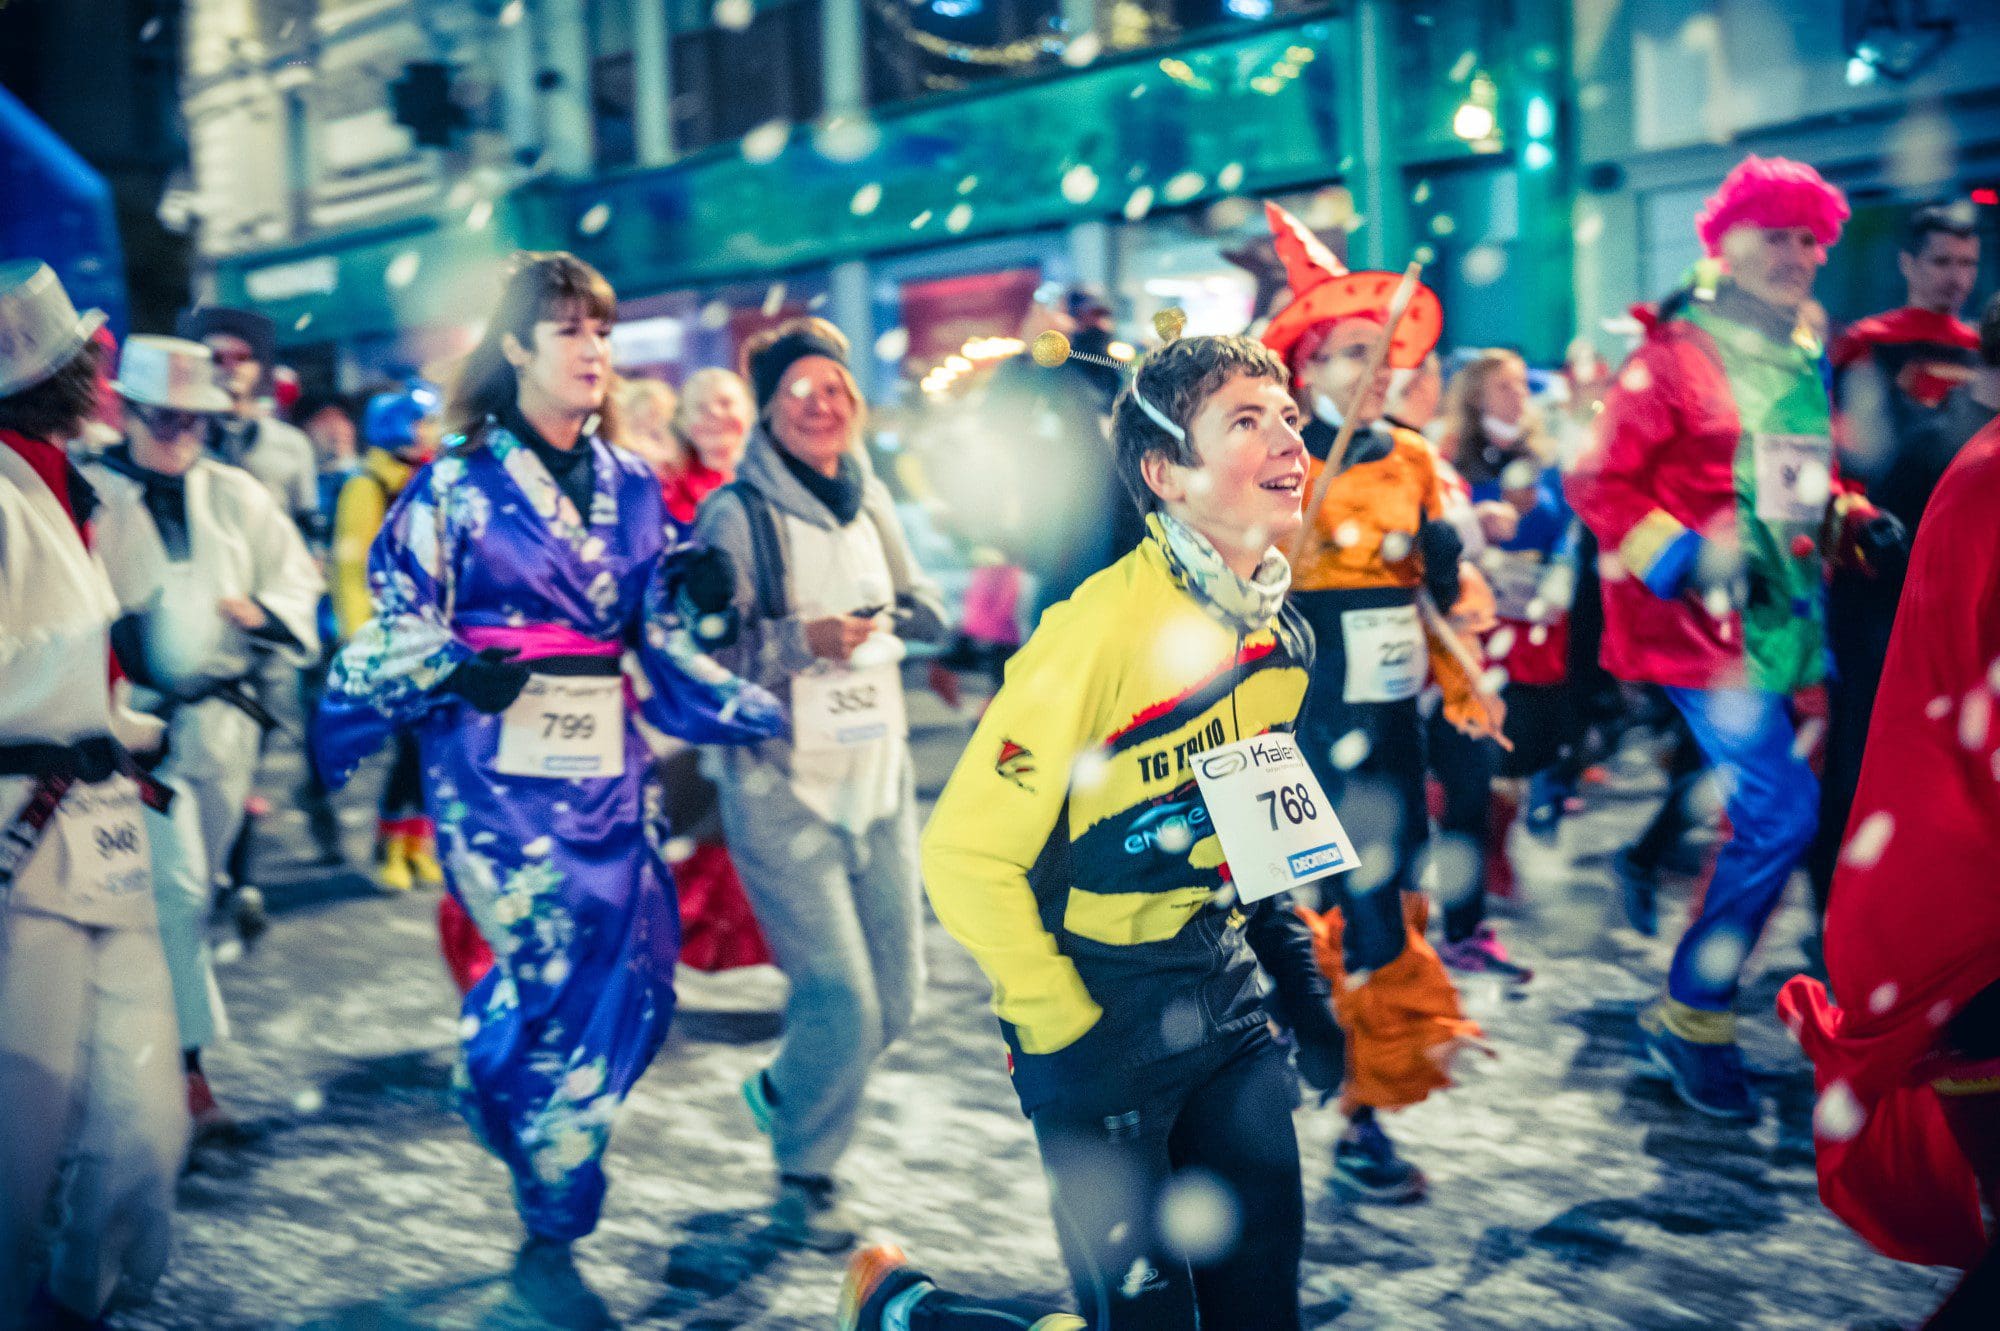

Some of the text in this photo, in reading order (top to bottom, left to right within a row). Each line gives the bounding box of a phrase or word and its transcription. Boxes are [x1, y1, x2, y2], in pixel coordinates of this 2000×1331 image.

[541, 712, 597, 739] 799
[1138, 751, 1170, 784] TG
[1255, 782, 1318, 832] 768
[1124, 806, 1207, 855] ene
